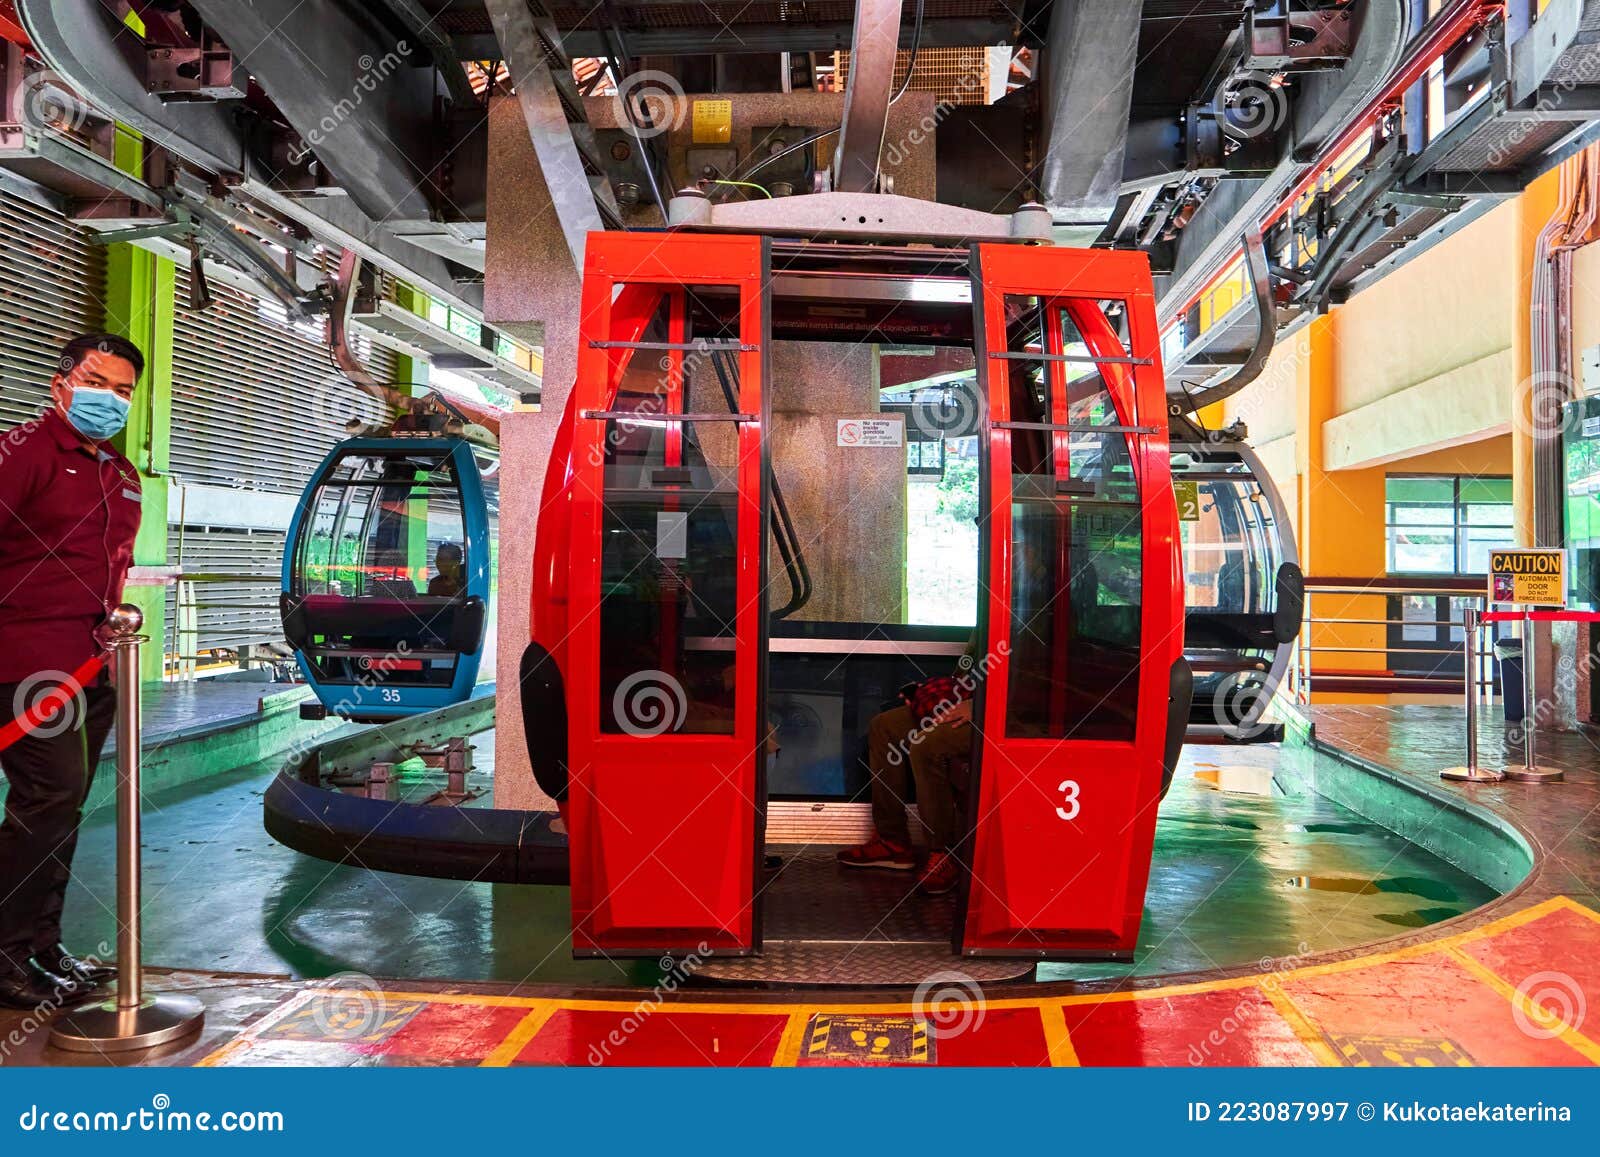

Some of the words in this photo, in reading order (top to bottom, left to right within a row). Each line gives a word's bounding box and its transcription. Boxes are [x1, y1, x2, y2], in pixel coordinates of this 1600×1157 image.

[1183, 501, 1196, 519] 2
[1493, 555, 1560, 573] CAUTION
[381, 688, 401, 702] 35
[1056, 779, 1081, 820] 3
